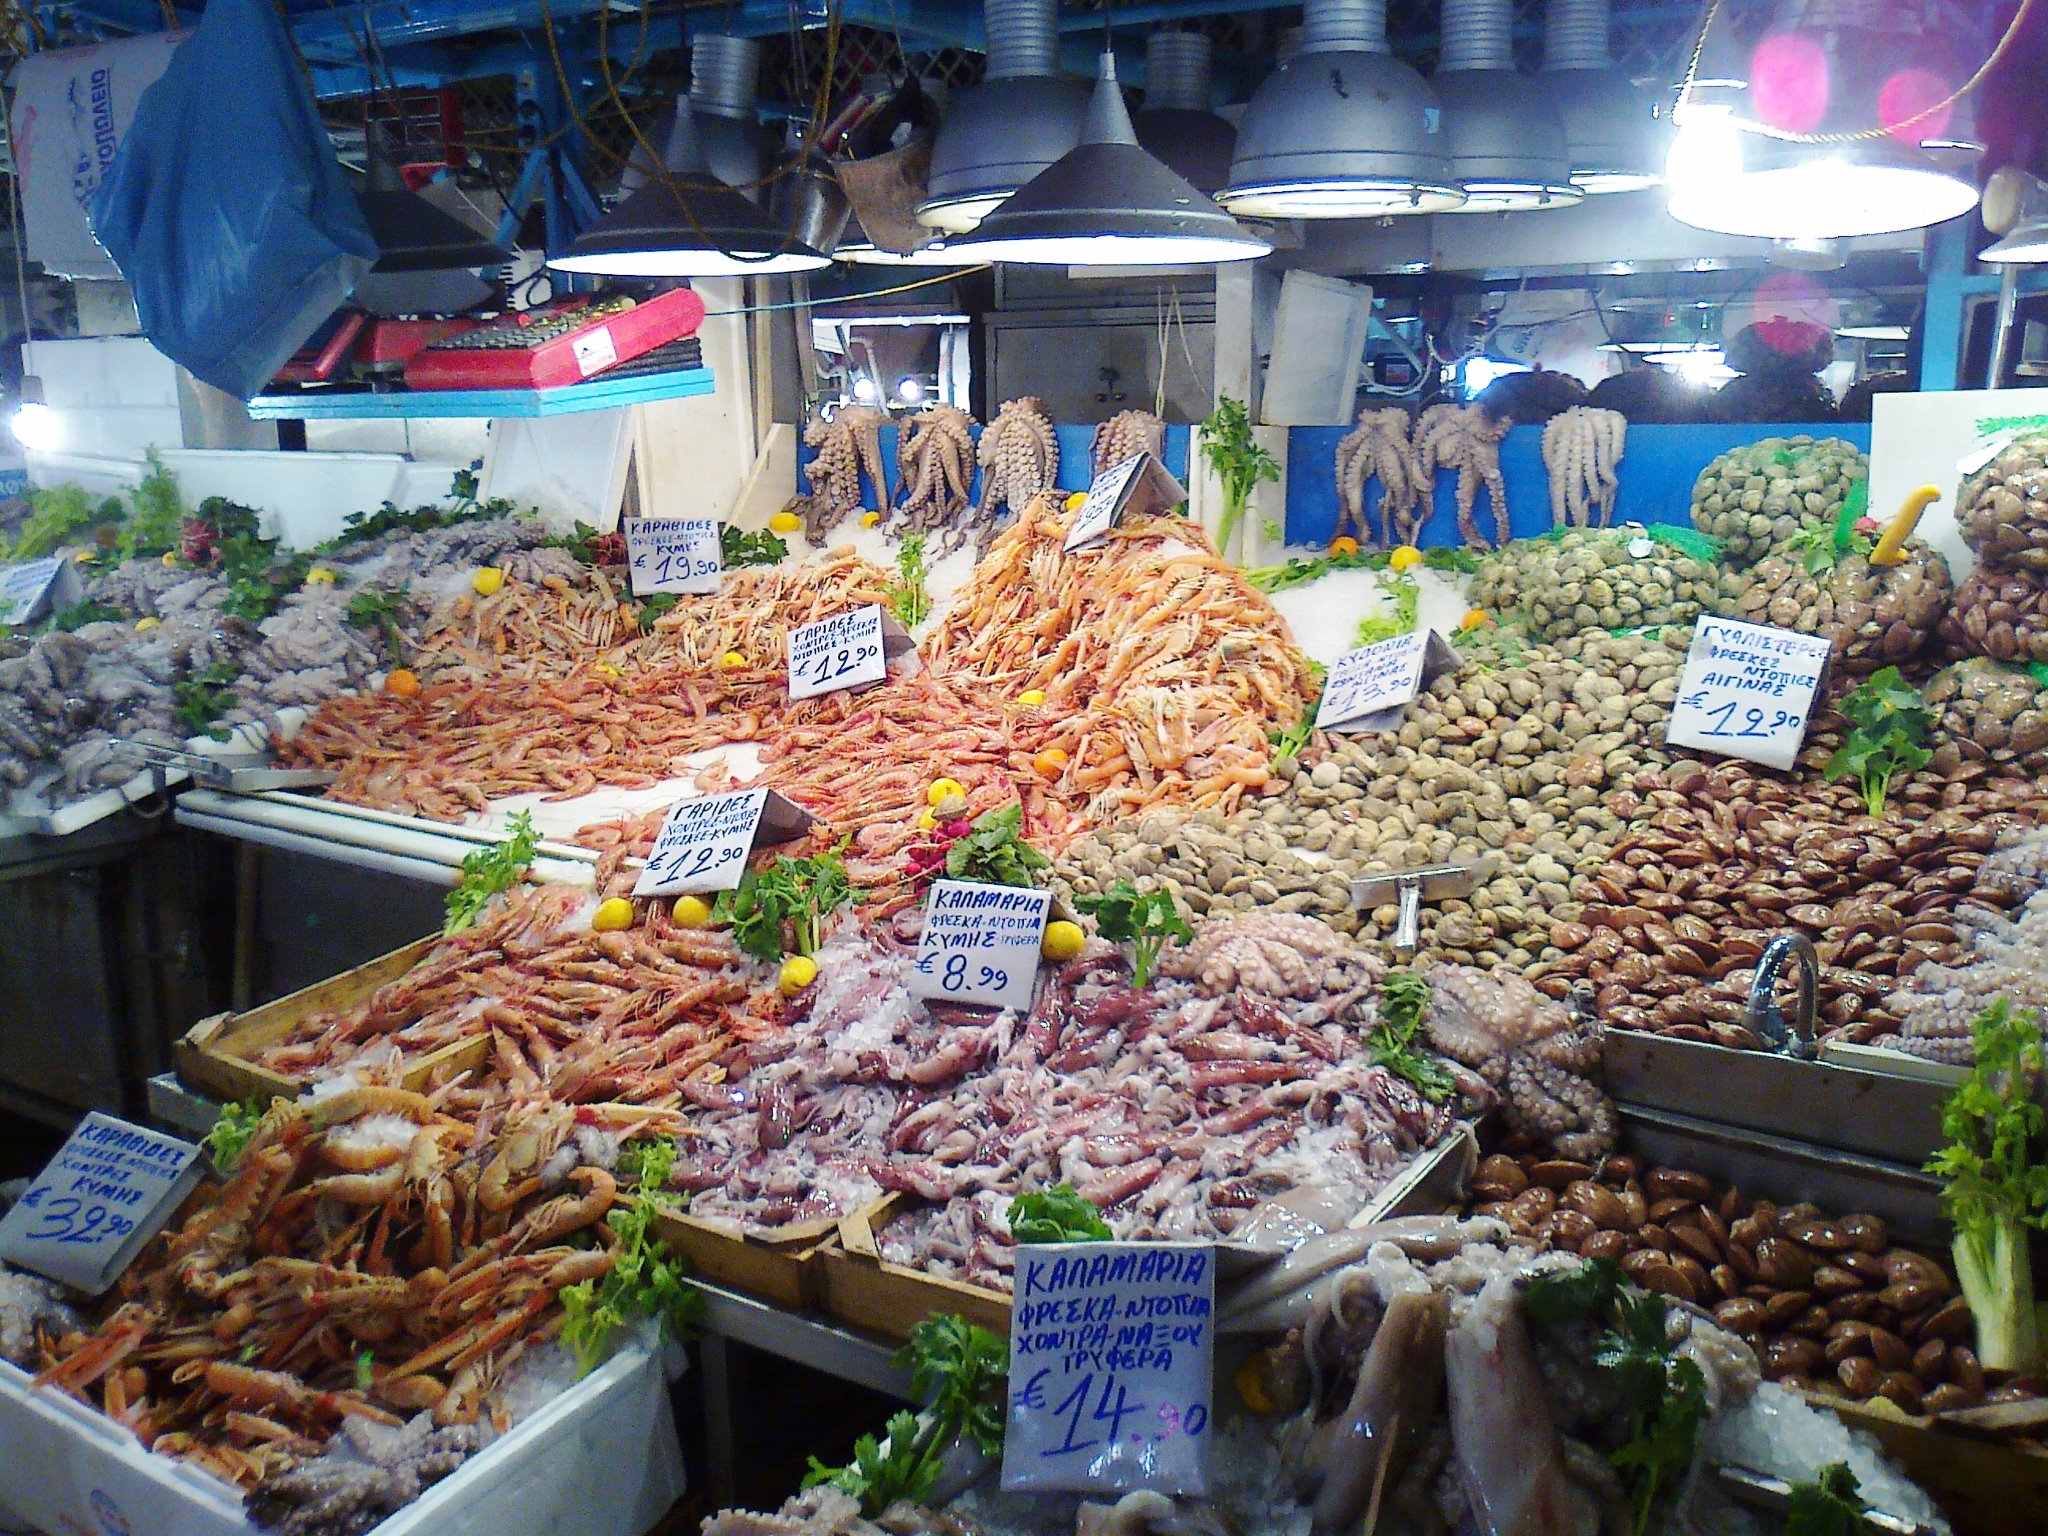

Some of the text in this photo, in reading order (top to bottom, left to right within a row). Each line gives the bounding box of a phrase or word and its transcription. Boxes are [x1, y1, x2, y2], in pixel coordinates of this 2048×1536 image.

[795, 613, 856, 643] ΓΑΡΙΔΕΣ
[673, 793, 755, 821] ΓΑΡΙΔΕΣ
[935, 889, 1044, 914] ΚΑΛΑΜΑΡΙΑ
[924, 931, 997, 949] ΚΥΜΗΣ
[1025, 1249, 1207, 1297] ΚΑΛΑΜΑΡΙΑ
[1062, 1346, 1173, 1374] ΤΡΥΦΕΡΑ
